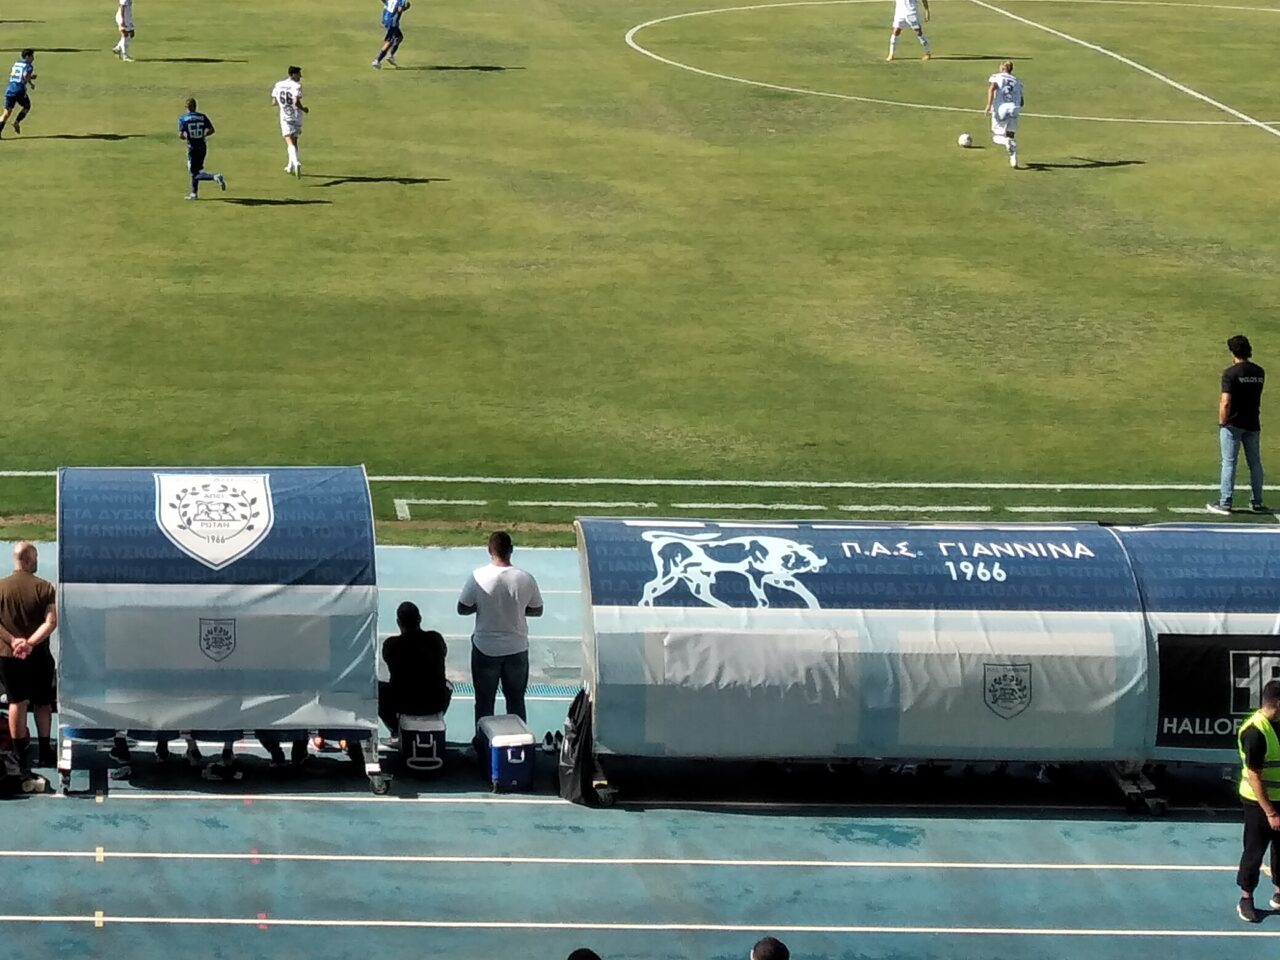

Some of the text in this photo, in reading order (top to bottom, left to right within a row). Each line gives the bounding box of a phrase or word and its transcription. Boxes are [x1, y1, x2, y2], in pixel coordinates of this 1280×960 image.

[280, 90, 293, 105] 66
[188, 122, 204, 138] 66
[206, 534, 226, 544] 1966
[840, 541, 1096, 560] Π.Α.Σ. ΓΙΑΝΝΙΝΑ
[944, 560, 1009, 582] 1966
[1163, 717, 1242, 735] HALLOF
